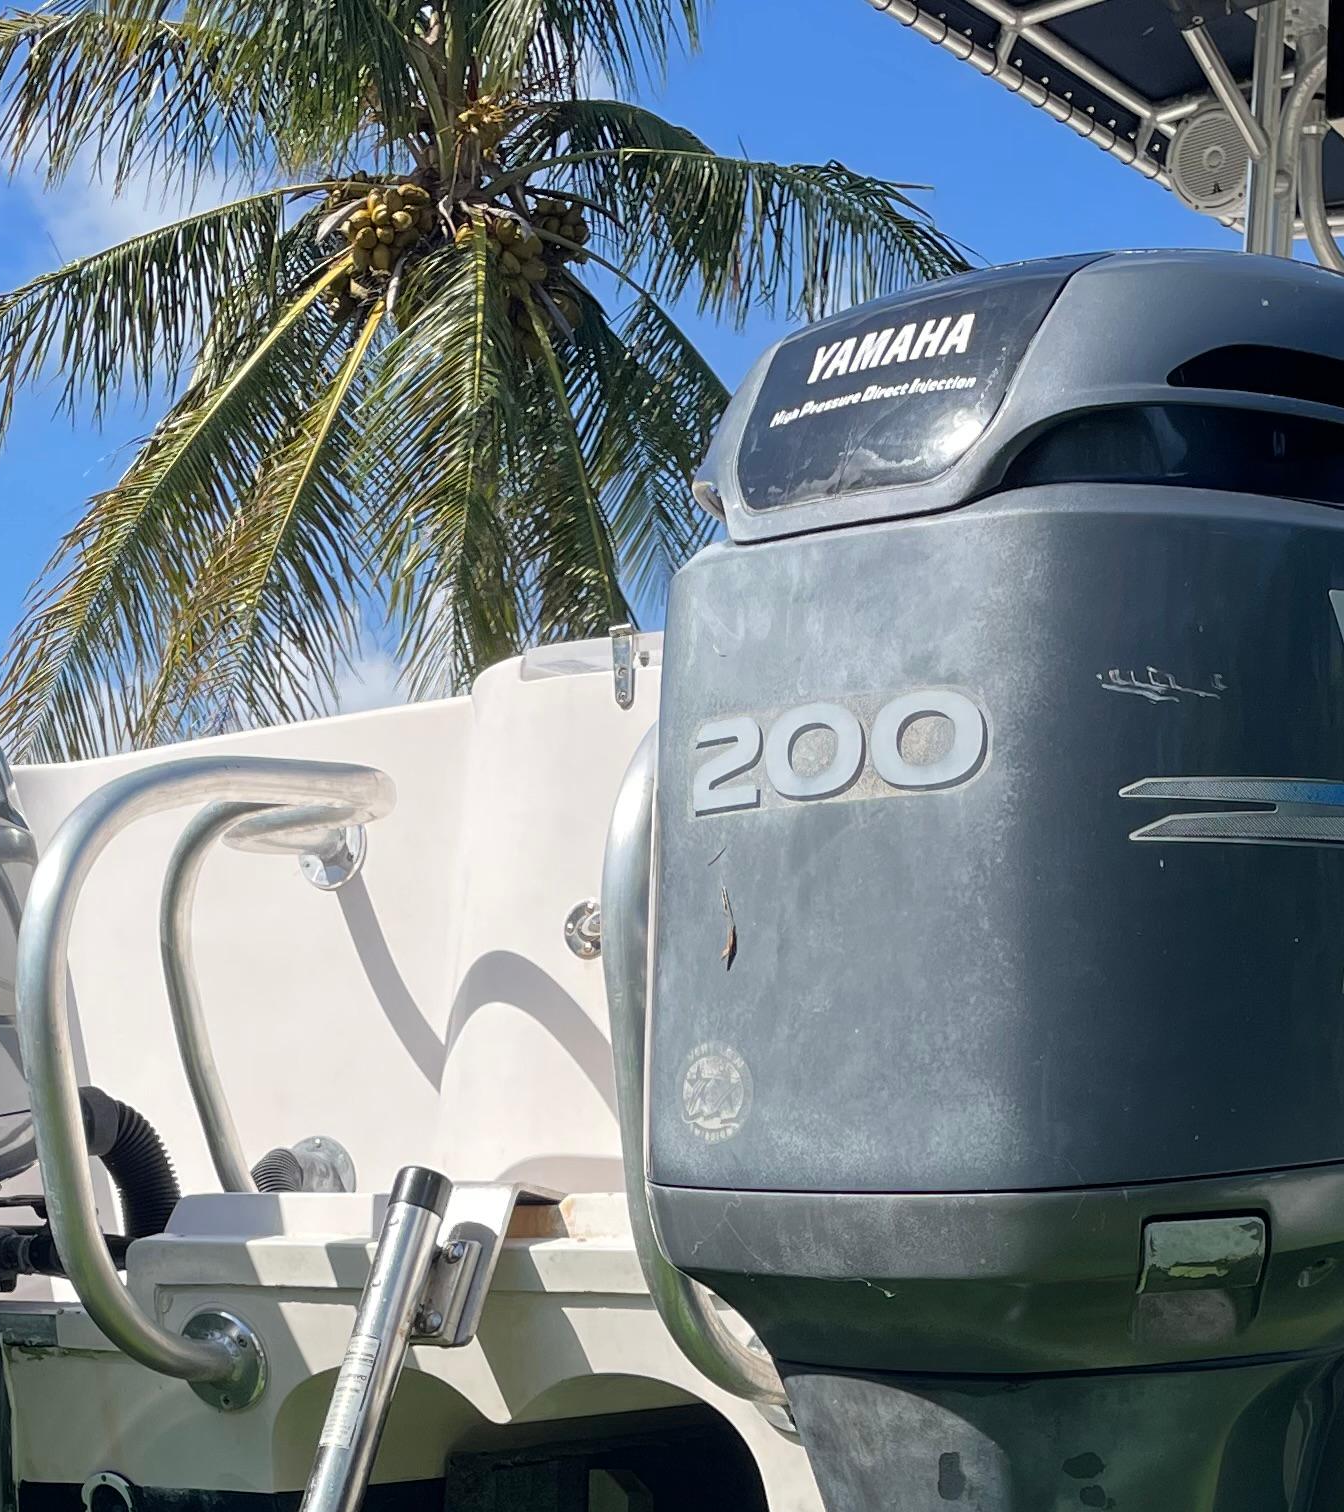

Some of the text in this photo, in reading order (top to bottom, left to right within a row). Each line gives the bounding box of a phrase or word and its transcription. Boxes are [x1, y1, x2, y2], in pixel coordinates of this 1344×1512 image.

[807, 313, 976, 385] YAMAHA
[770, 375, 977, 428] High Pressure Direct Injection
[694, 690, 989, 817] 200
